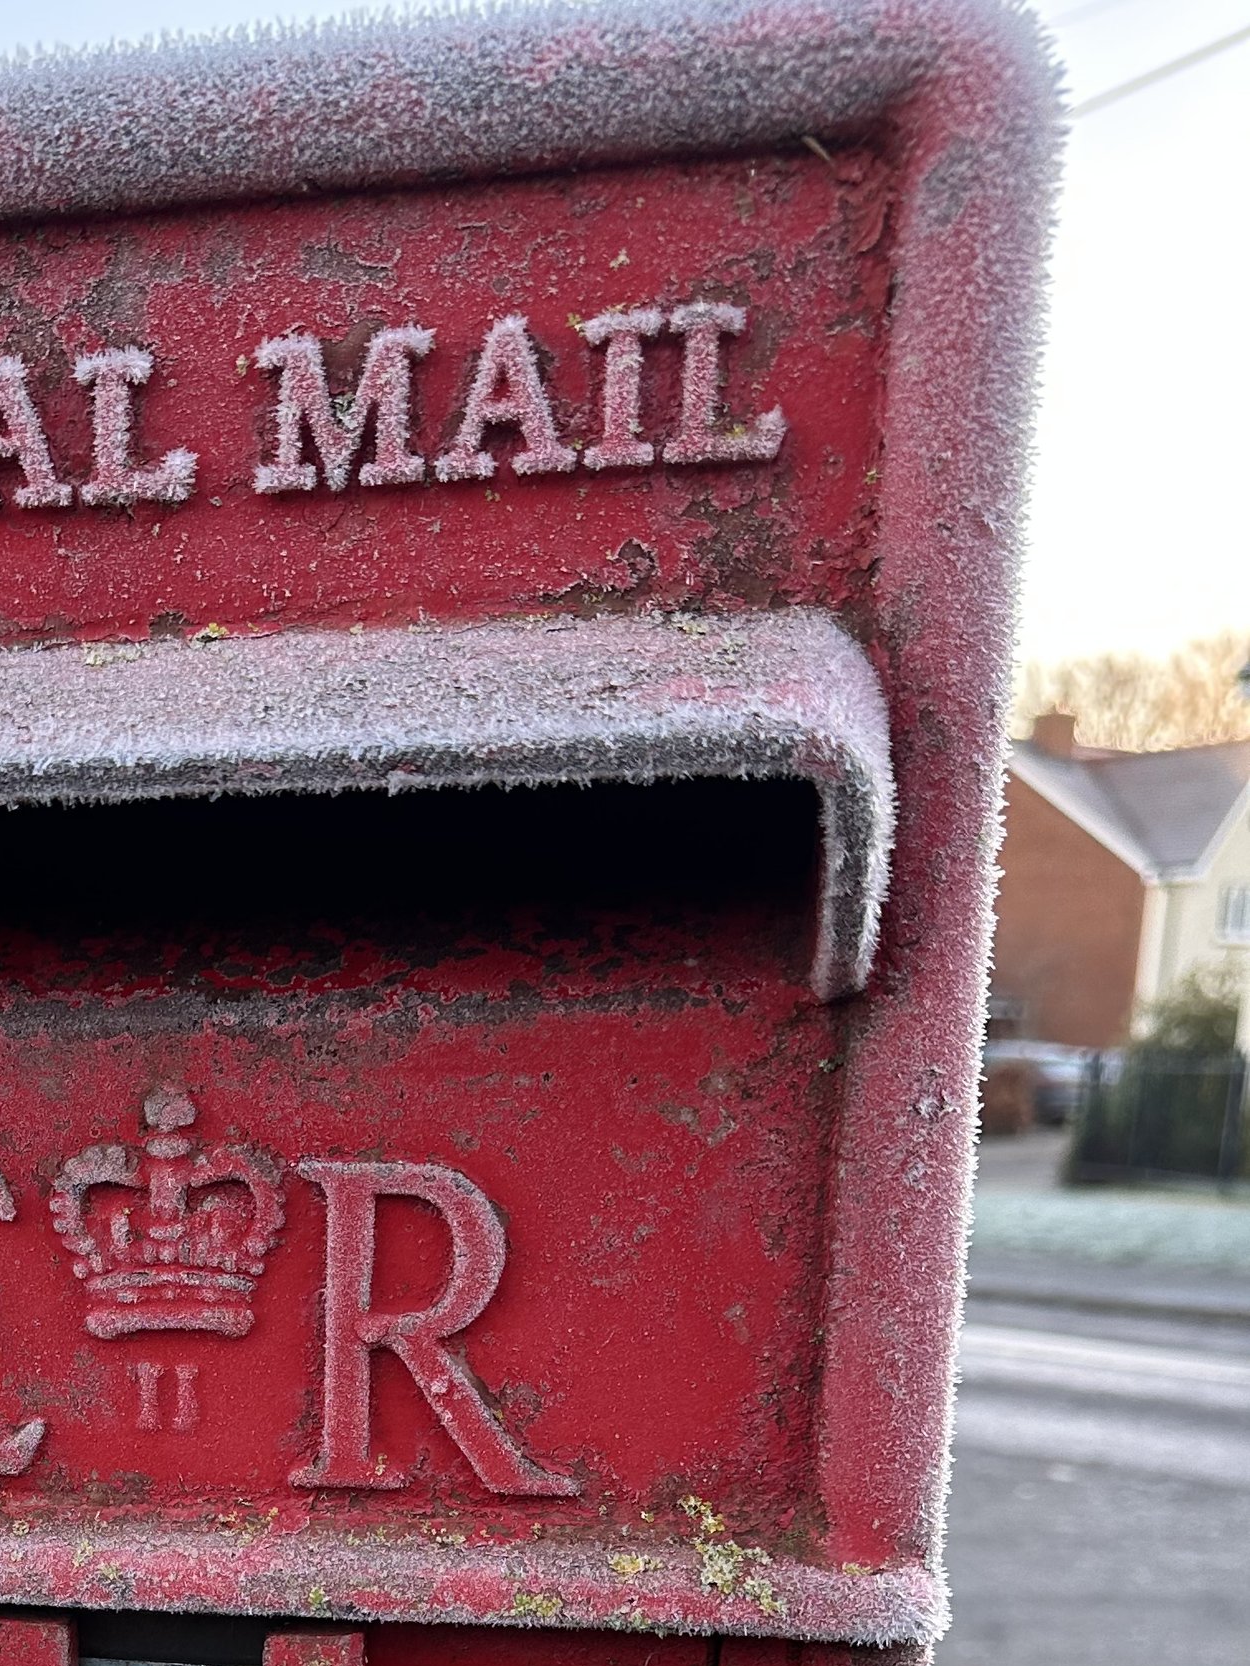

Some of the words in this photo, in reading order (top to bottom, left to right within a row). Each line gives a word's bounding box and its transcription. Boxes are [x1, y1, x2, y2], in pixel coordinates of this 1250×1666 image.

[253, 302, 786, 496] MAIL
[129, 1361, 200, 1431] II
[287, 1156, 583, 1498] R
